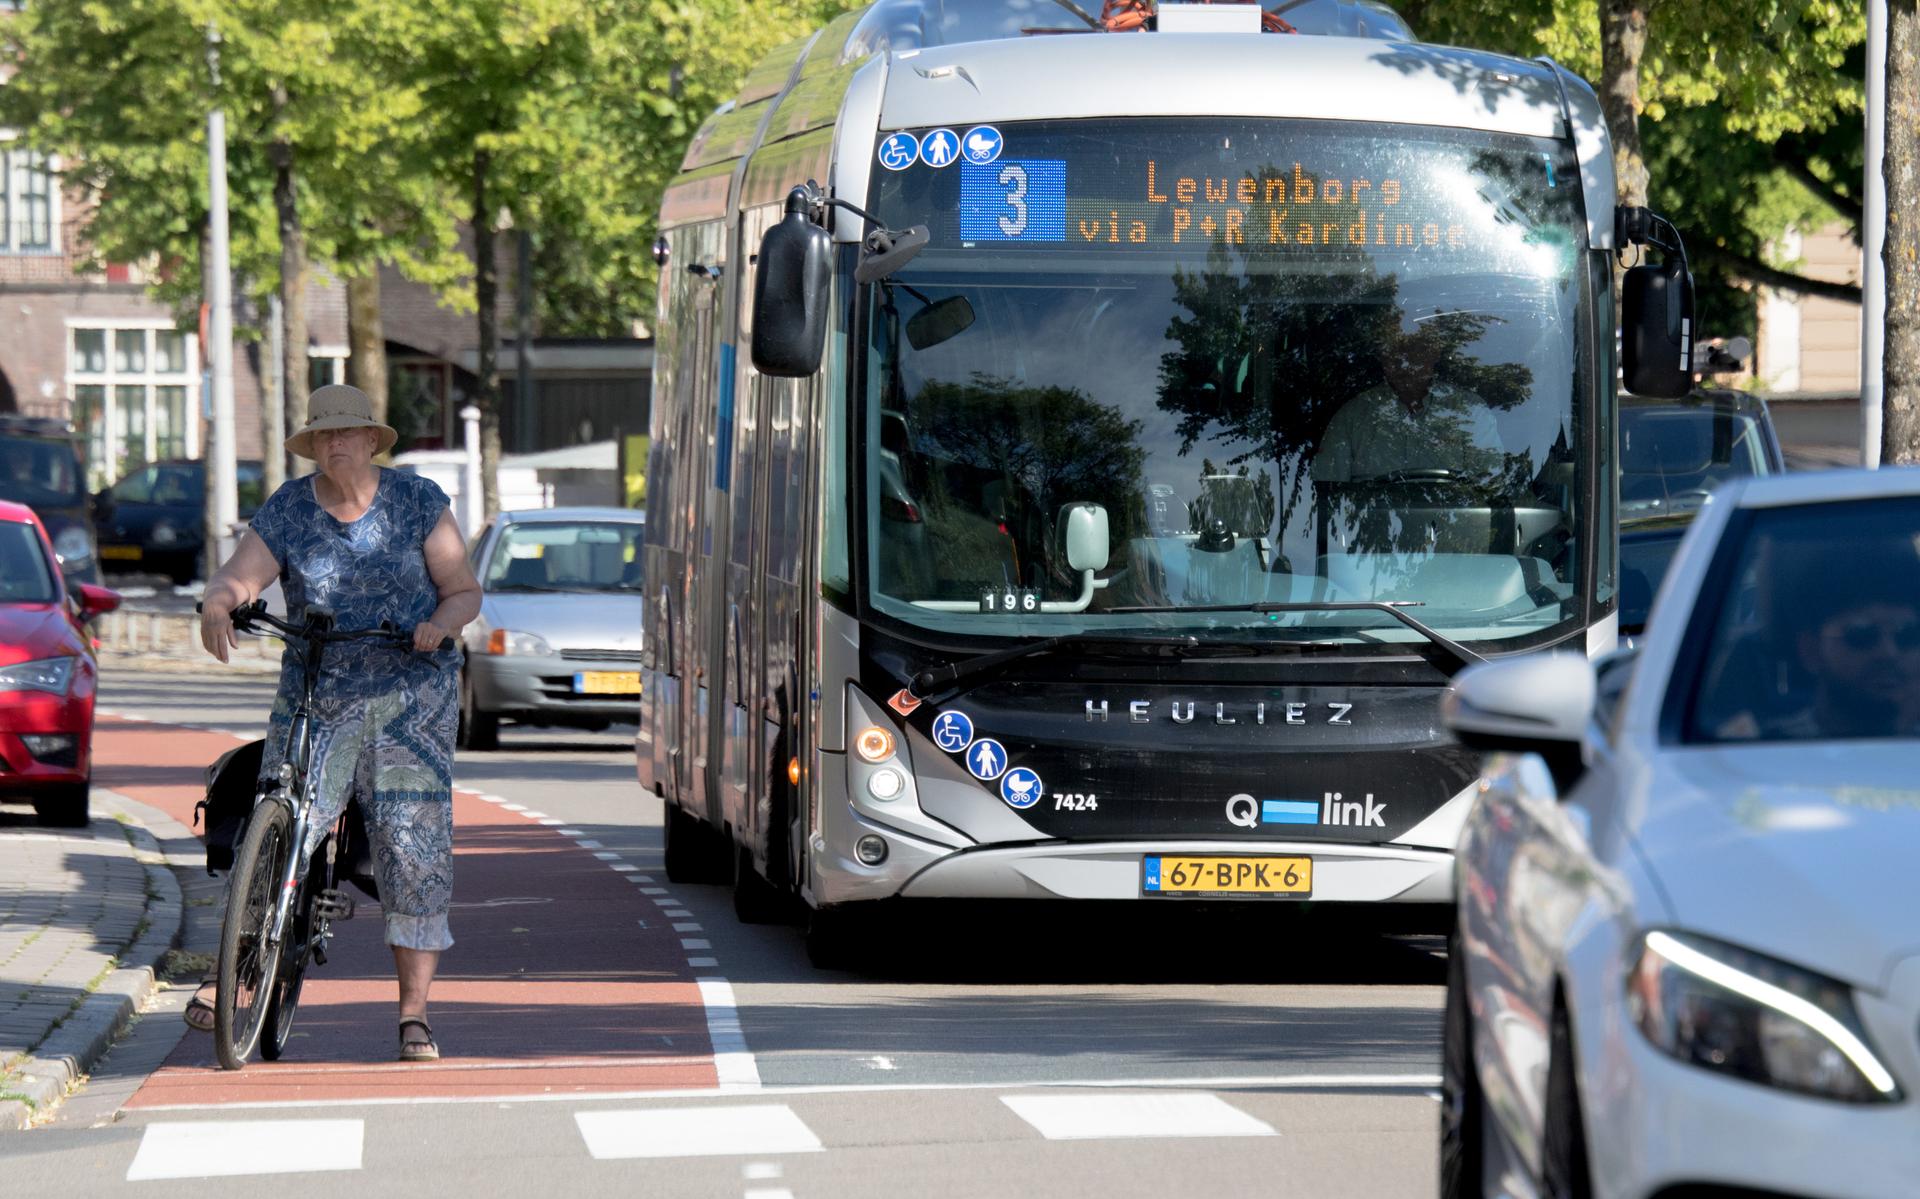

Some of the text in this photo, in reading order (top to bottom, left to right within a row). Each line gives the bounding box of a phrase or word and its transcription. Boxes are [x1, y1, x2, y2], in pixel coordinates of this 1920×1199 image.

[1148, 160, 1401, 205] Lewenborg
[999, 164, 1028, 236] 3
[1079, 209, 1147, 244] via
[1172, 207, 1244, 245] P+R
[985, 593, 1036, 610] 196
[1085, 700, 1353, 726] HEULIEZ
[1052, 793, 1099, 811] 7424
[1225, 792, 1387, 829] Q link
[1147, 862, 1300, 888] NL 67-BPK-6
